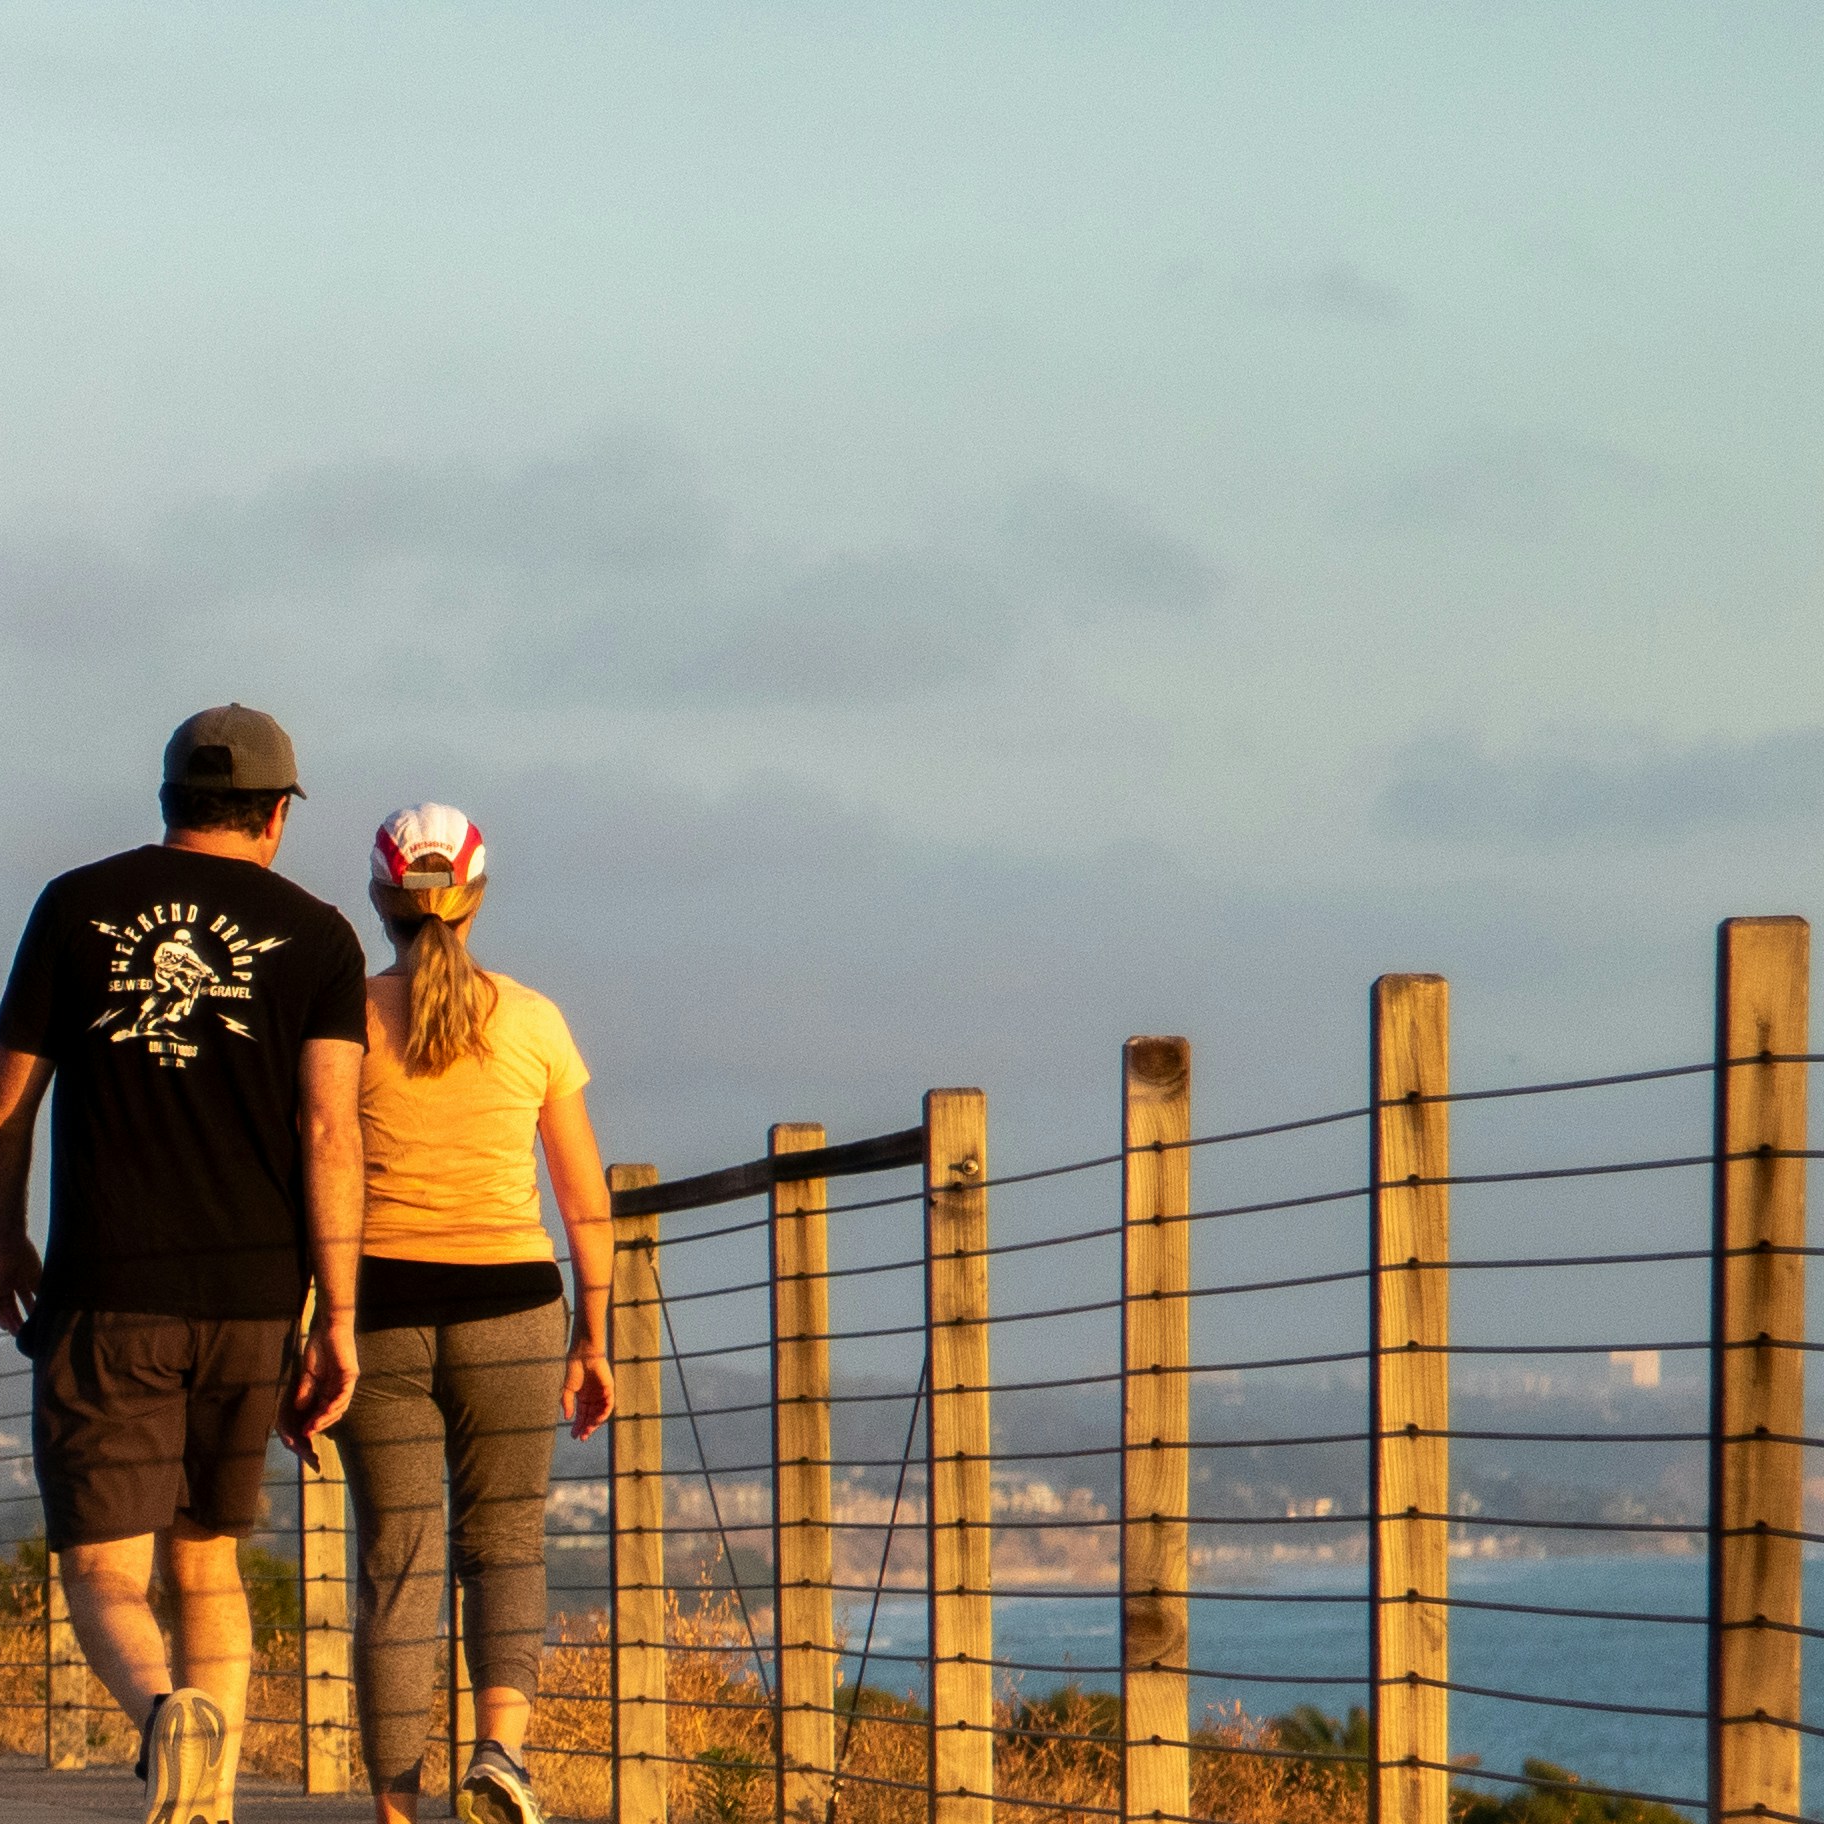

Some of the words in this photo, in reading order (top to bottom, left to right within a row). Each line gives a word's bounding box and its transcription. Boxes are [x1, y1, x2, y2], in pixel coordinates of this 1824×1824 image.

[111, 903, 198, 972] WEEKEND
[209, 914, 253, 981] BRAAP
[107, 978, 154, 992] SEAWEED
[209, 985, 253, 999] GRAVEL
